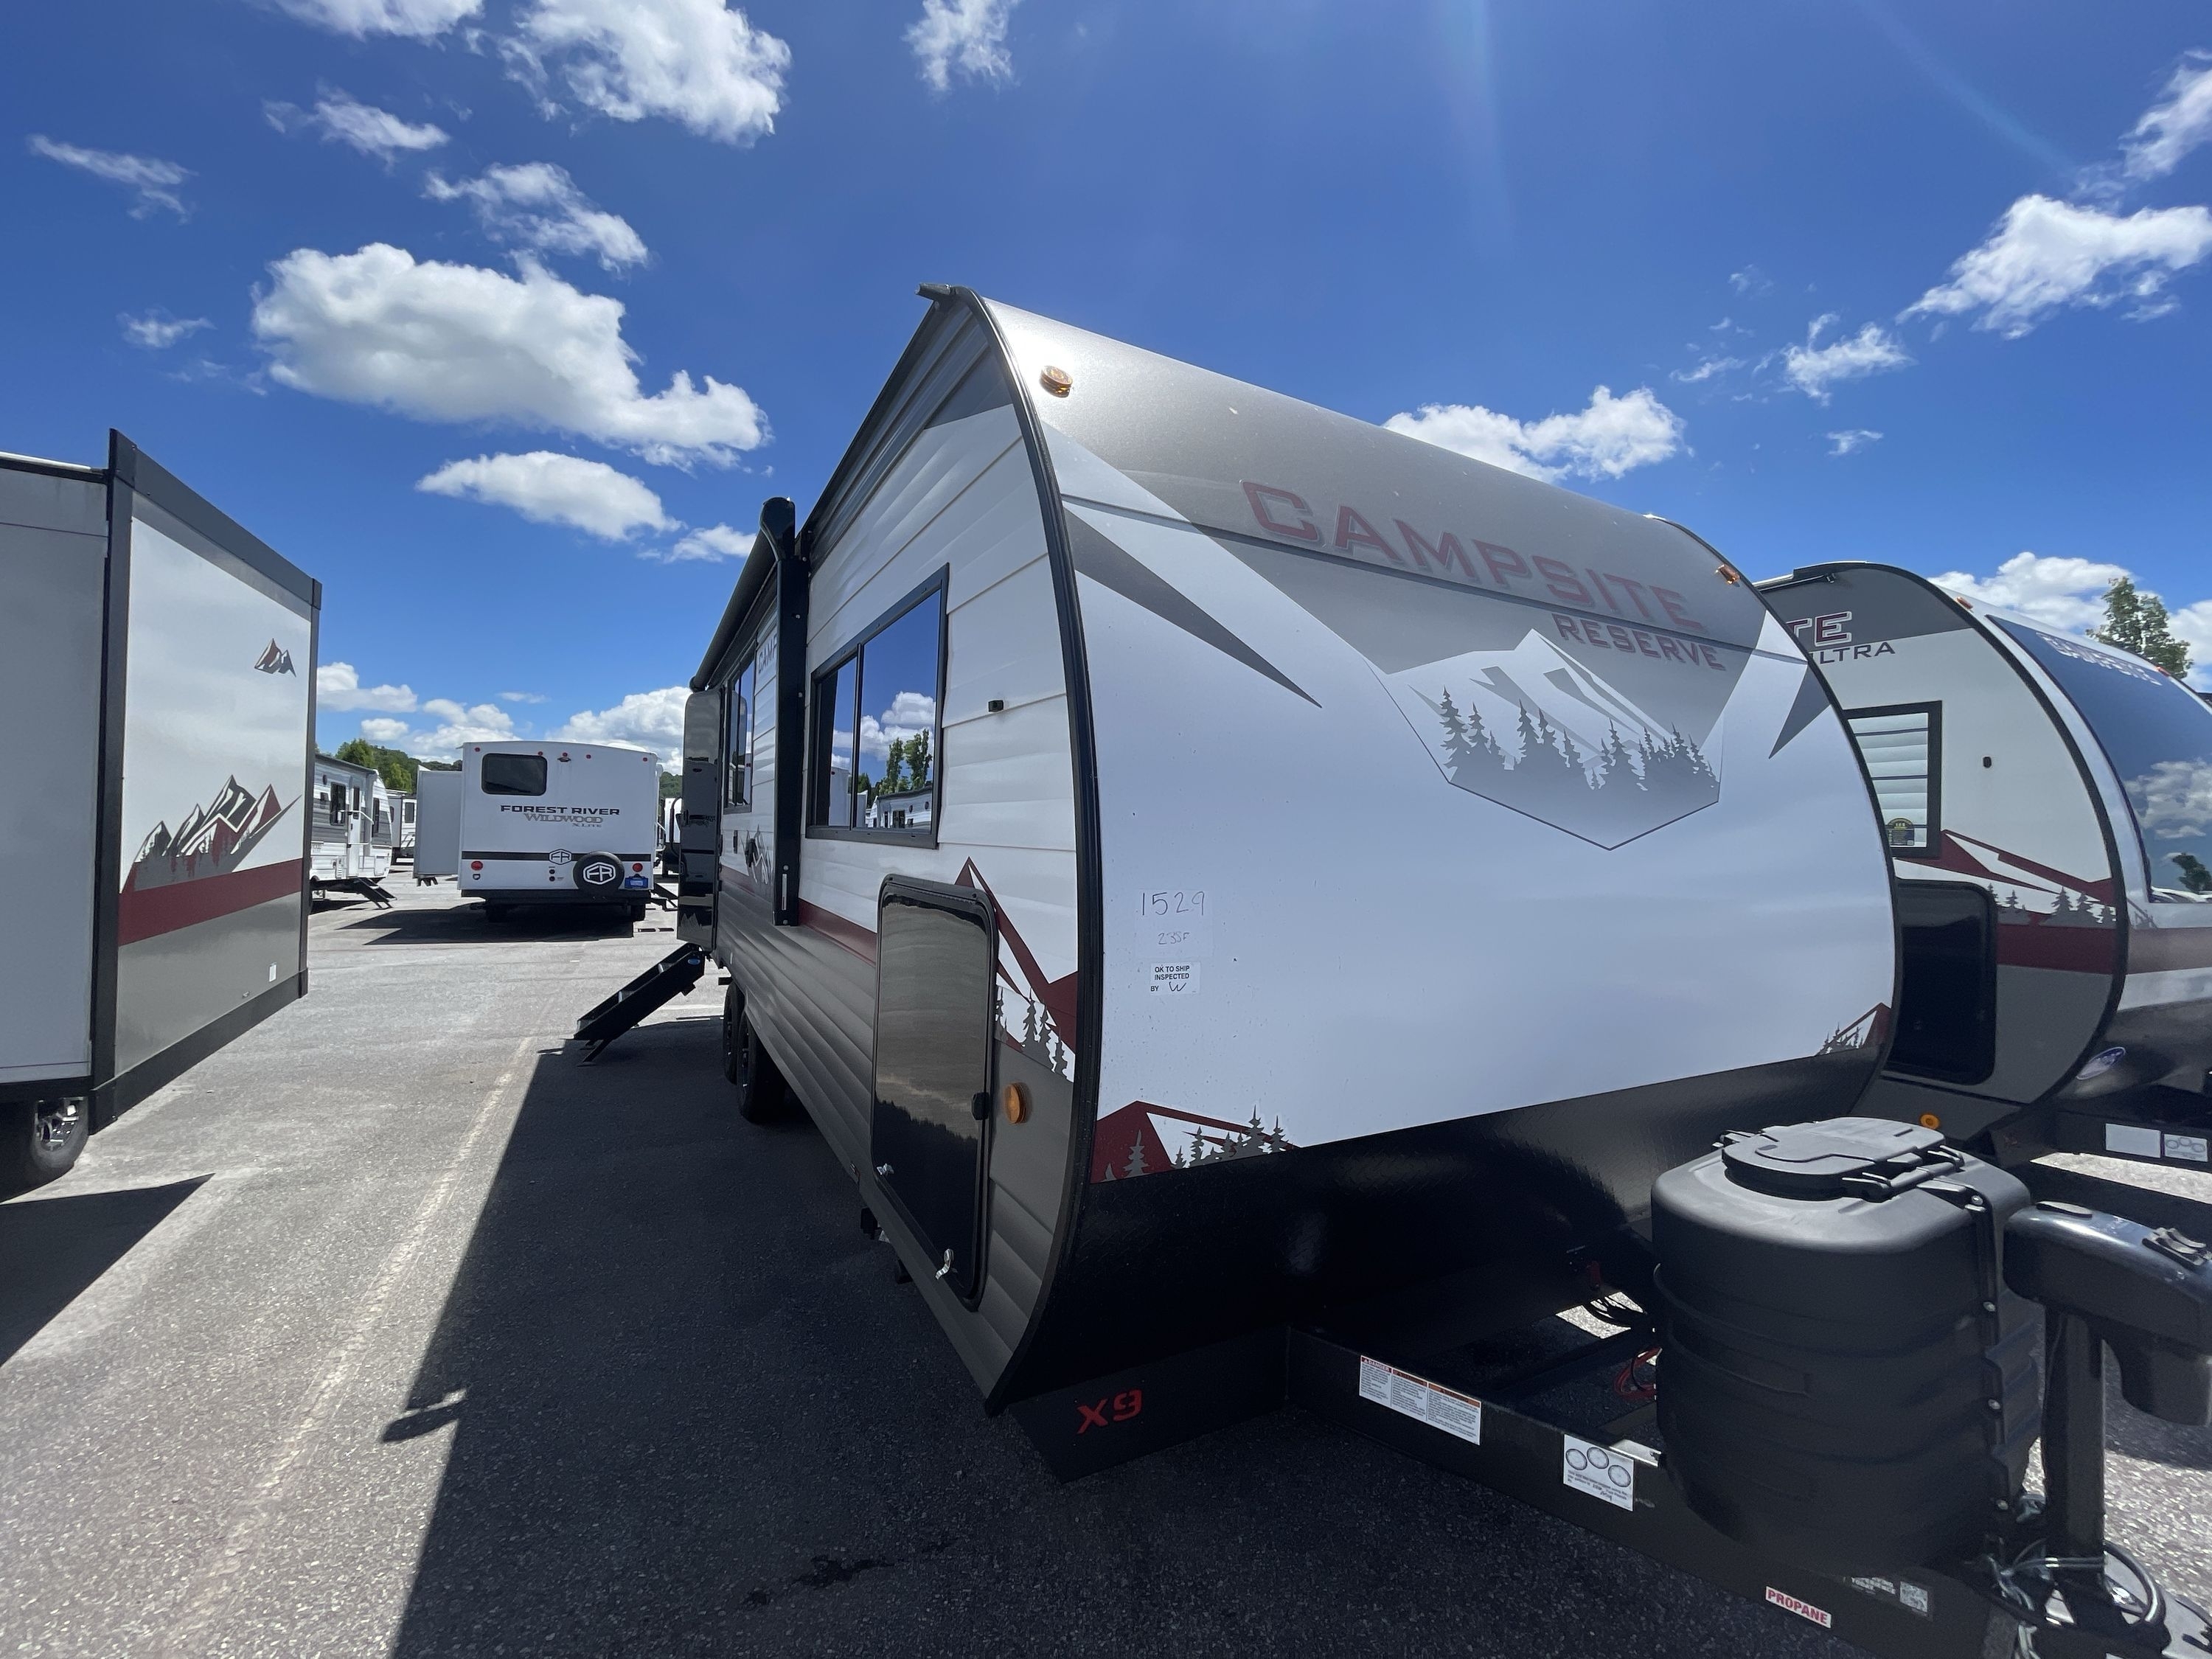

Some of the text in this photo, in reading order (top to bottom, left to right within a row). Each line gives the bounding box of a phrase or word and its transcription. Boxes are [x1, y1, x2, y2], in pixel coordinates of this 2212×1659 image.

[1239, 480, 1702, 630] CAMPSITE
[1551, 613, 1725, 669] RESERVE
[501, 804, 620, 815] FOREST RIVER
[1142, 891, 1205, 916] 1529
[1155, 973, 1189, 981] INSPECTED
[1077, 1388, 1142, 1434] X9
[1767, 1589, 1828, 1624] PROPANE
